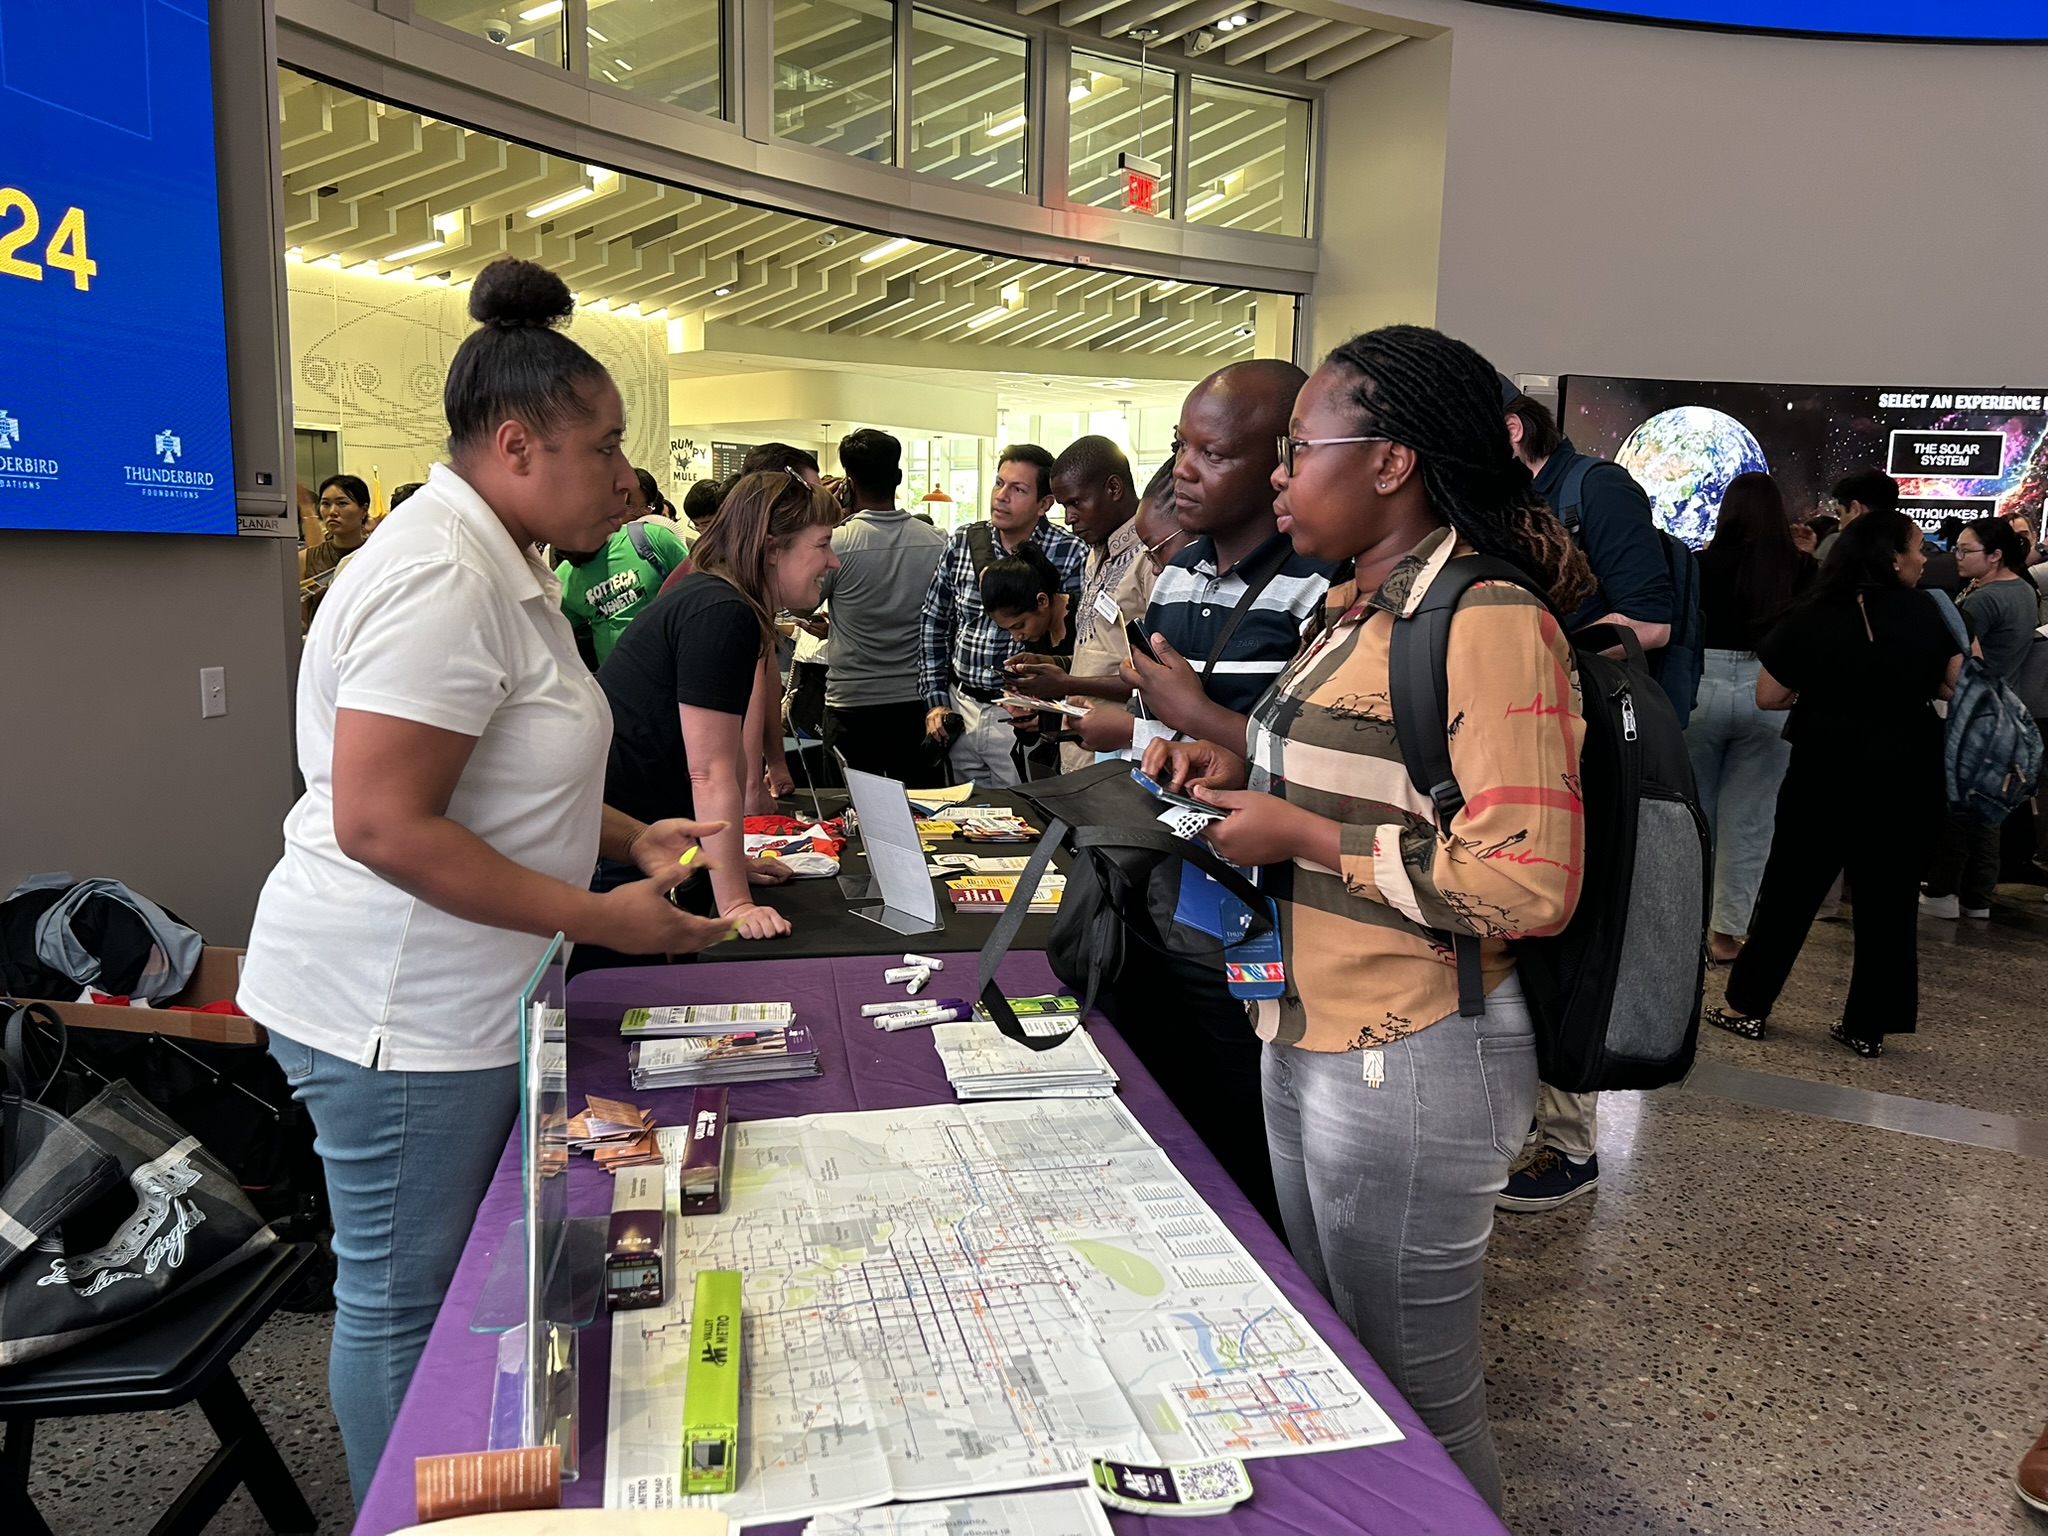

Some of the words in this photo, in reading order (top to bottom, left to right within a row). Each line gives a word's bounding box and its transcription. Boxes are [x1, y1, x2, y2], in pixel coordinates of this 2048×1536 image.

[1129, 174, 1154, 211] EXIT
[0, 187, 97, 292] 24
[1878, 393, 1929, 409] SELECT
[1930, 394, 1952, 409] AN
[1954, 395, 2041, 410] EXPERIENCE
[1913, 443, 1937, 455] THE
[1938, 443, 1980, 456] SOLAR
[1920, 455, 1970, 468] SYSTEM
[124, 465, 214, 486] THUNDERBIRD
[673, 472, 698, 482] MULE
[142, 488, 200, 500] FOUNDATIONS
[237, 518, 279, 530] PLANAR
[1895, 507, 1977, 520] ARTHQUAKES
[1979, 509, 1989, 519] &
[585, 568, 638, 606] BOTTEGA
[598, 588, 638, 616] VENETA
[704, 1318, 714, 1342] VALLEY
[716, 1314, 729, 1344] METRO
[628, 1483, 636, 1504] VALLEY
[637, 1479, 648, 1505] METRO
[654, 1477, 663, 1493] MAP
[809, 1473, 819, 1498] Surprise
[1155, 1473, 1168, 1496] METRO
[931, 1517, 988, 1530] Youngtown
